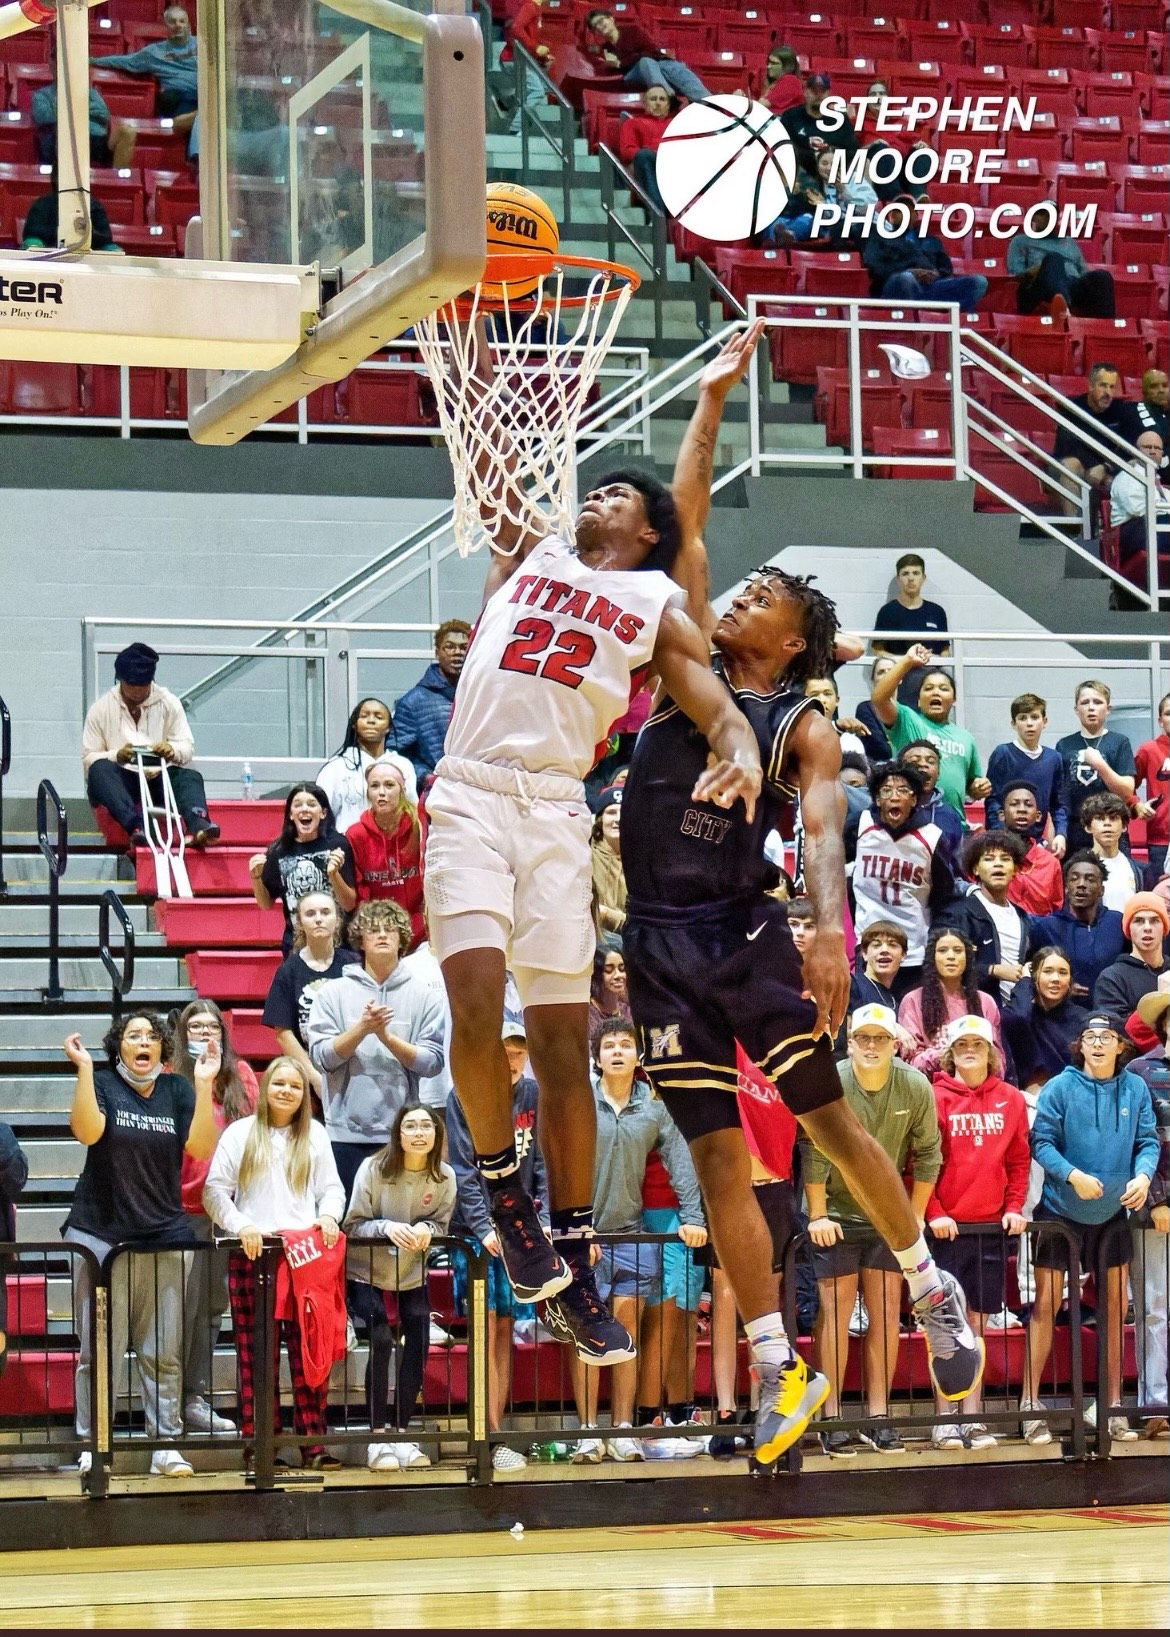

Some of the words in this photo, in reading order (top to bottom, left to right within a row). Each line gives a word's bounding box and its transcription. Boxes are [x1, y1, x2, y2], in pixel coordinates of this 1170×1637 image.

[486, 210, 538, 240] Wils
[10, 307, 32, 320] Play
[508, 574, 646, 645] TITANS
[498, 617, 597, 690] 22
[680, 808, 733, 844] CITY
[862, 854, 924, 886] TITANS
[880, 880, 901, 907] 11
[136, 1121, 151, 1131] YOU
[948, 1112, 1005, 1131] TITANS
